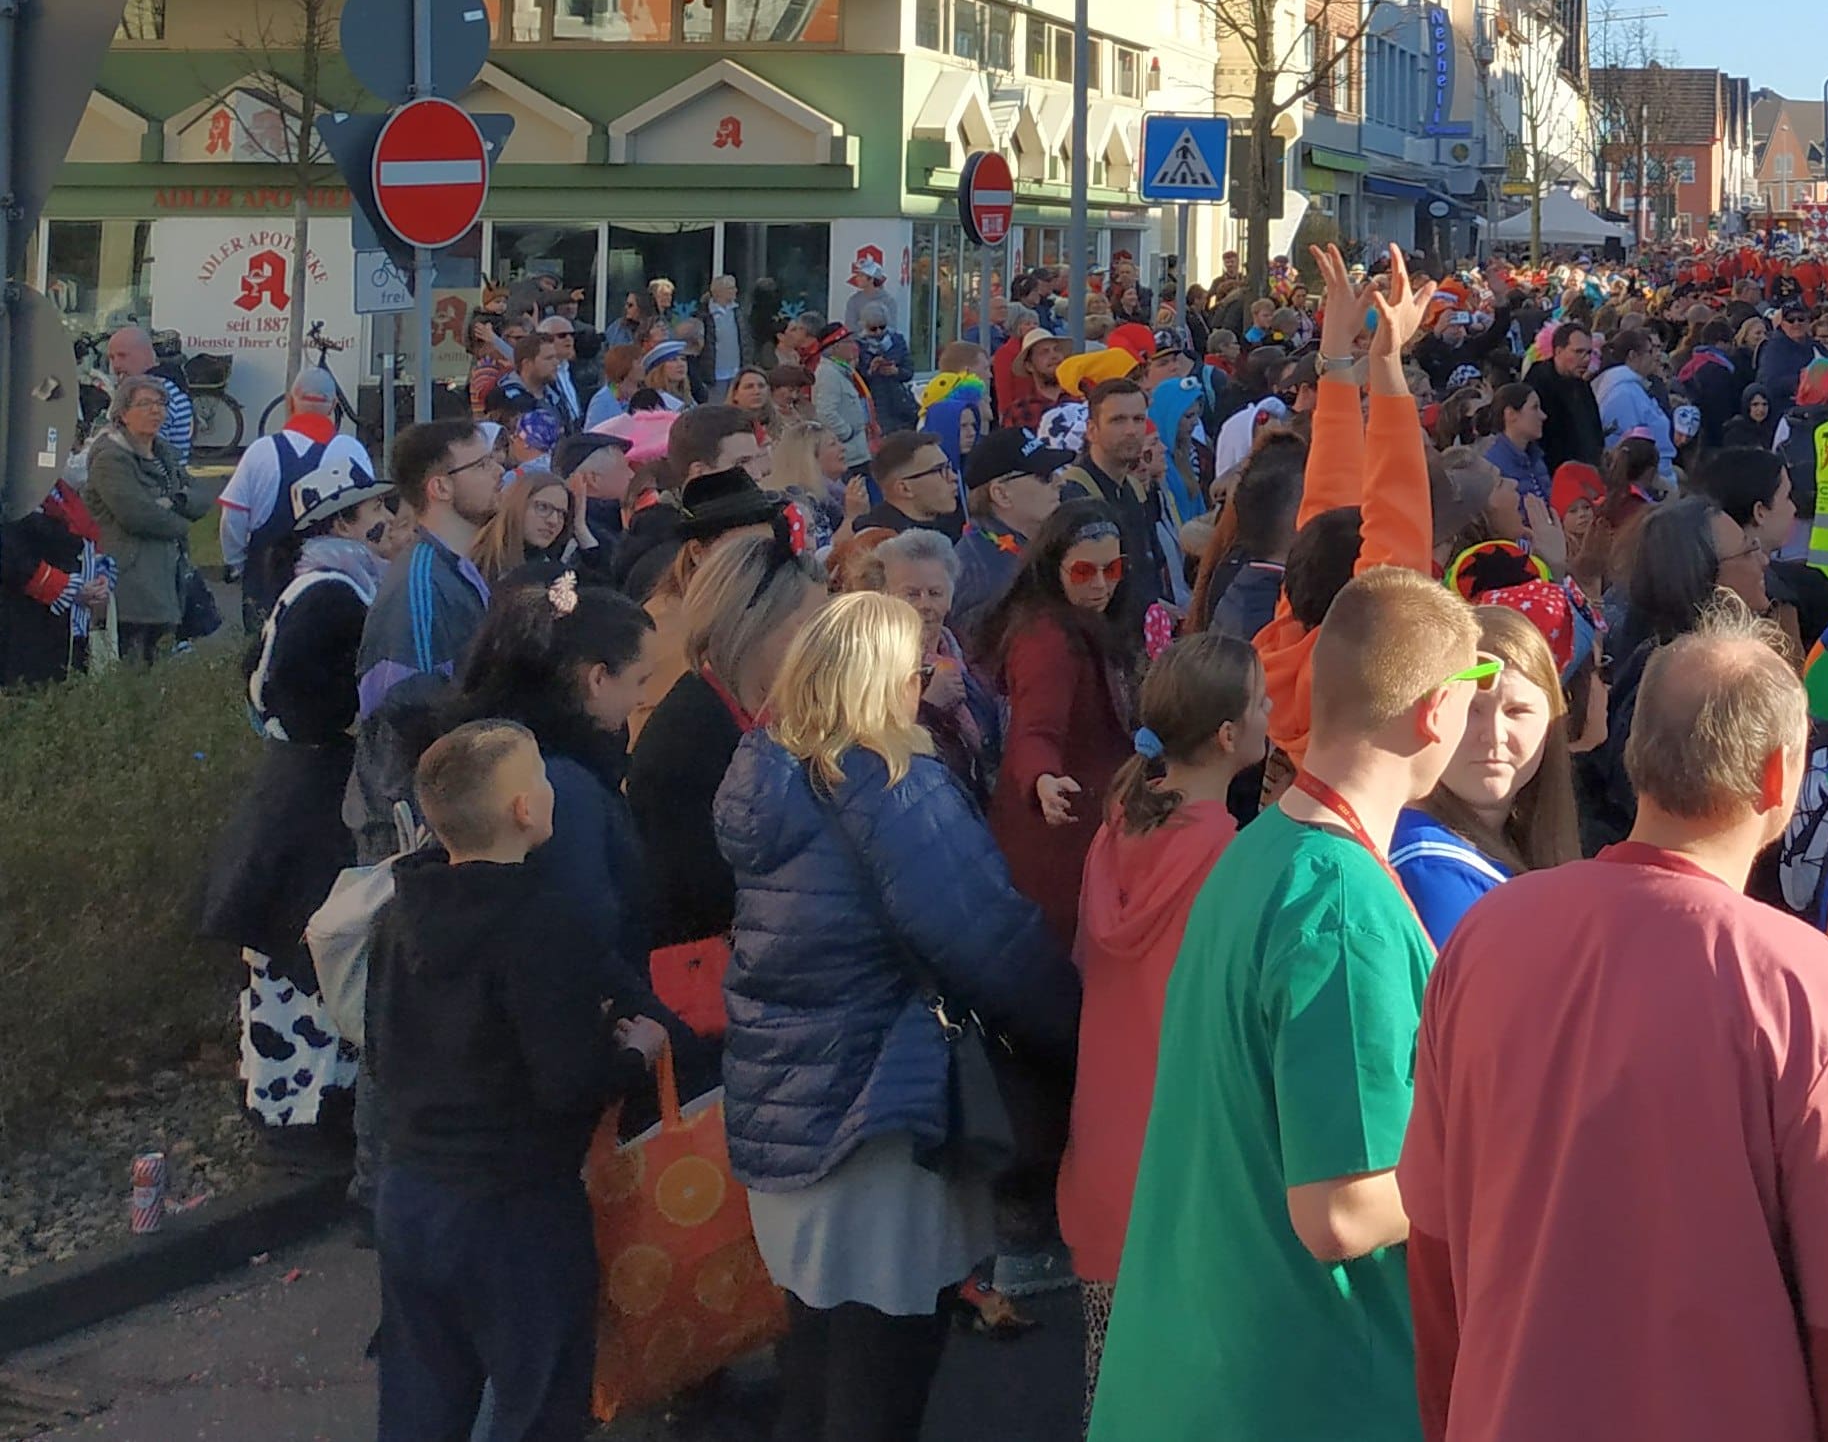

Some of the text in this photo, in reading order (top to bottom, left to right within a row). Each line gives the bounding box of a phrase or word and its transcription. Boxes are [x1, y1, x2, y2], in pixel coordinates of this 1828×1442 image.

[197, 230, 330, 286] ADLER APOTEKE
[381, 289, 406, 304] frei
[226, 316, 290, 333] seit 1887
[186, 336, 235, 349] Dienste
[238, 336, 272, 349] Ihrer
